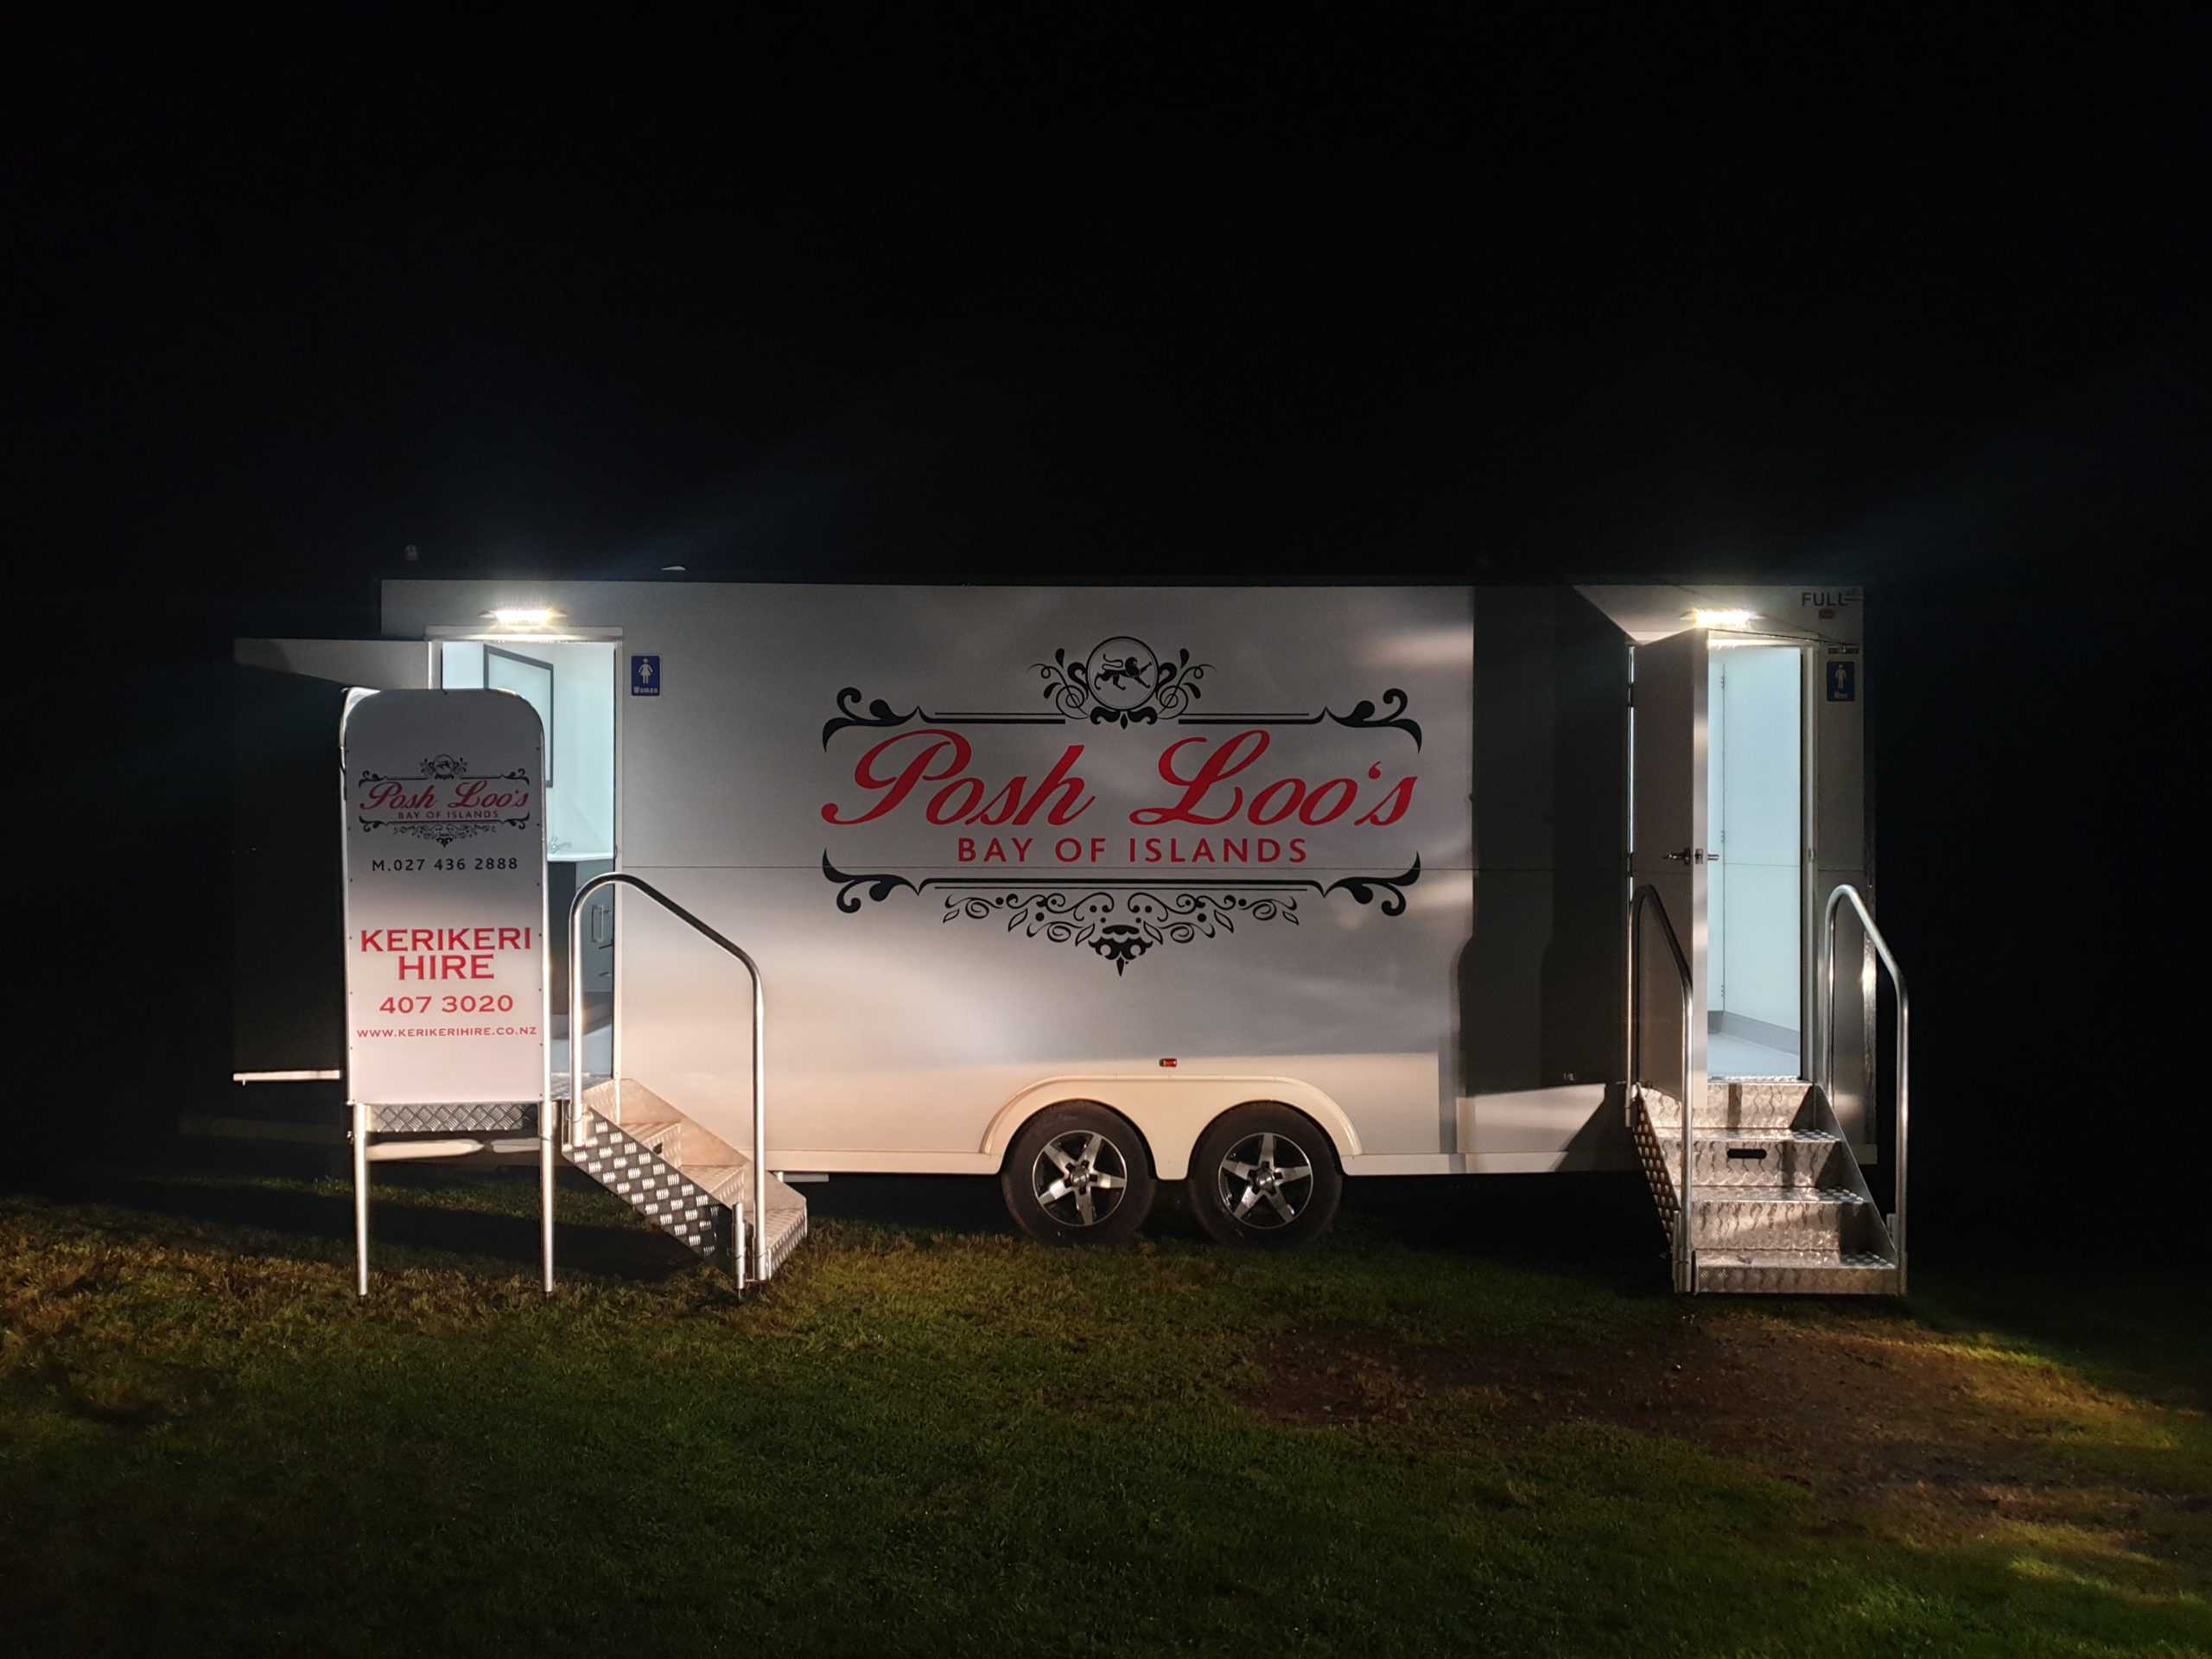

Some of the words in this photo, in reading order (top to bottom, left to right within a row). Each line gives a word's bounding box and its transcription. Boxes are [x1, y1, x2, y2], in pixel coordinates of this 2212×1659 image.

[1802, 592, 1848, 607] FULL
[821, 728, 1096, 826] Posh
[1128, 729, 1419, 826] Loo's
[359, 781, 436, 810] Posh
[448, 780, 529, 809] Loo's
[398, 811, 420, 820] BAY
[426, 810, 442, 819] OF
[447, 810, 499, 819] ISLANDS
[957, 838, 1033, 862] BAY
[1056, 837, 1107, 862] OF
[1129, 837, 1307, 862] ISLANDS
[372, 859, 425, 872] M.027
[434, 859, 466, 871] 436
[475, 857, 518, 870] 2888
[361, 927, 531, 952] KERIKERI
[398, 953, 494, 980] HIRE
[379, 996, 432, 1014] 407
[442, 995, 513, 1013] 3020
[357, 1027, 537, 1038] WWW.KERIKERIHIRE.CO.NZ
